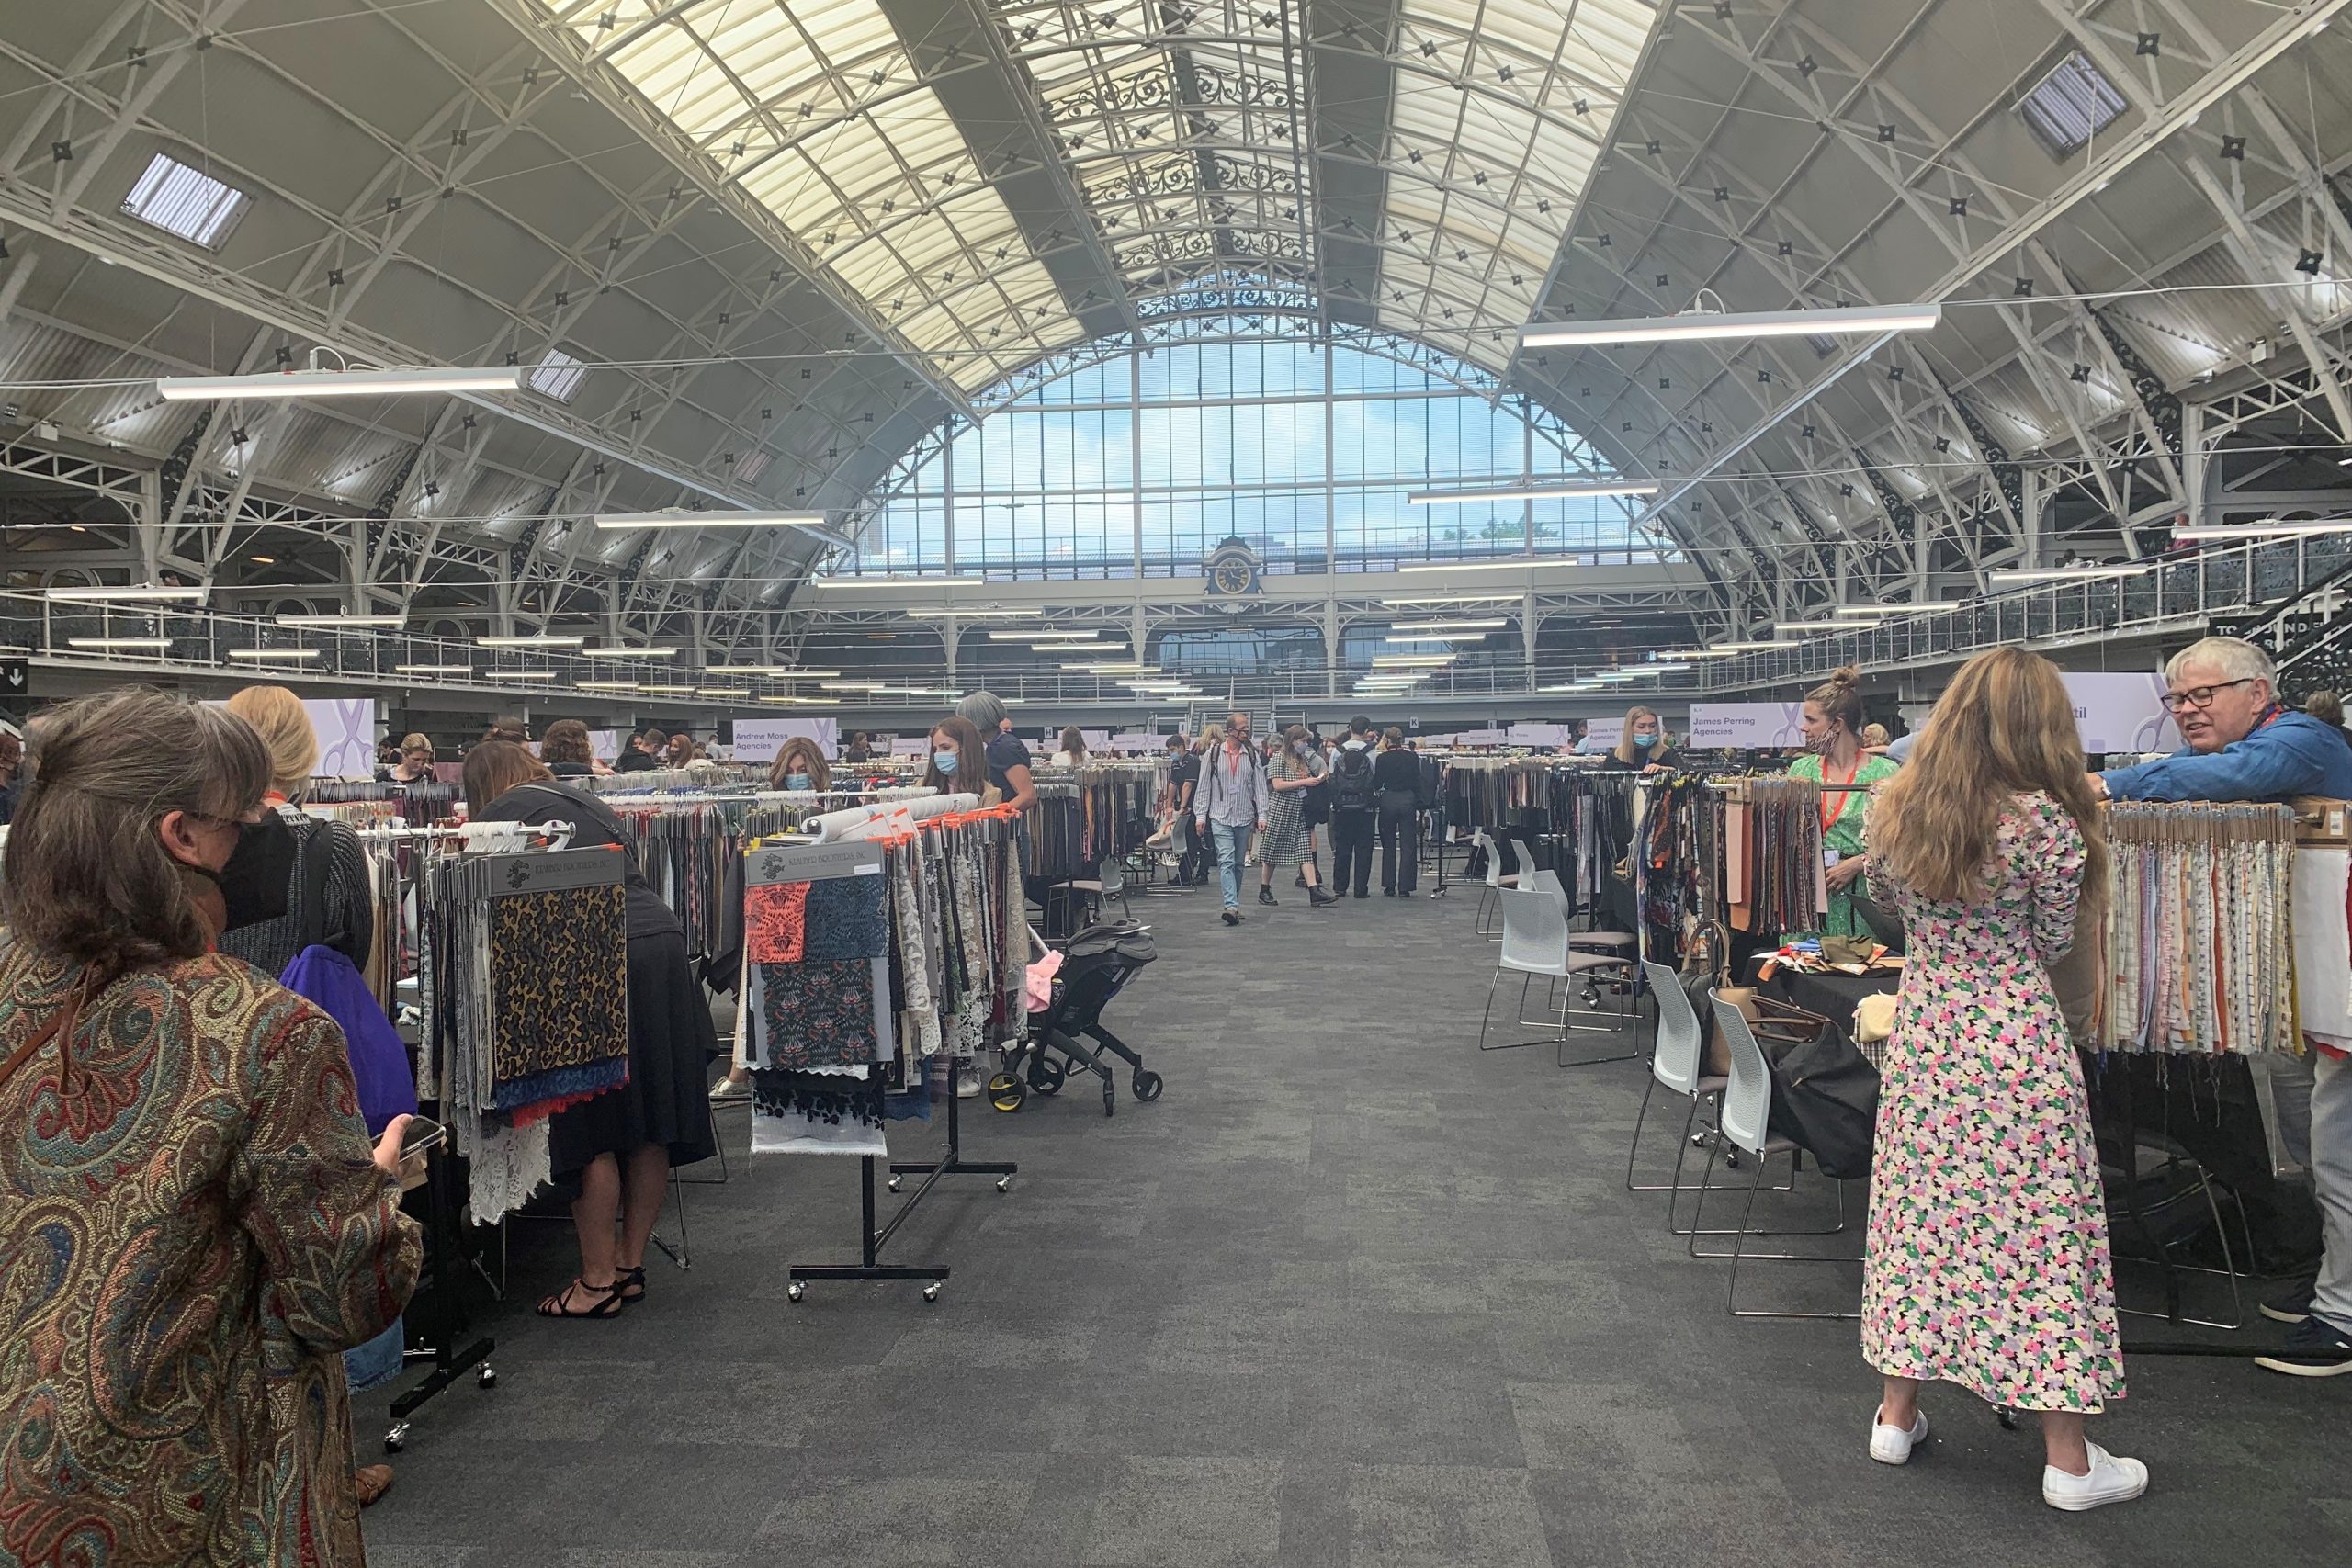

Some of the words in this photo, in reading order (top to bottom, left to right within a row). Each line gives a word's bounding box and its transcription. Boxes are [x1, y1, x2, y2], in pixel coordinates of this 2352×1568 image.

[2216, 625, 2237, 636] TO
[1693, 717, 1722, 726] James
[1724, 716, 1756, 727] Perring
[1693, 728, 1733, 736] Agencies
[736, 742, 772, 751] Agencies
